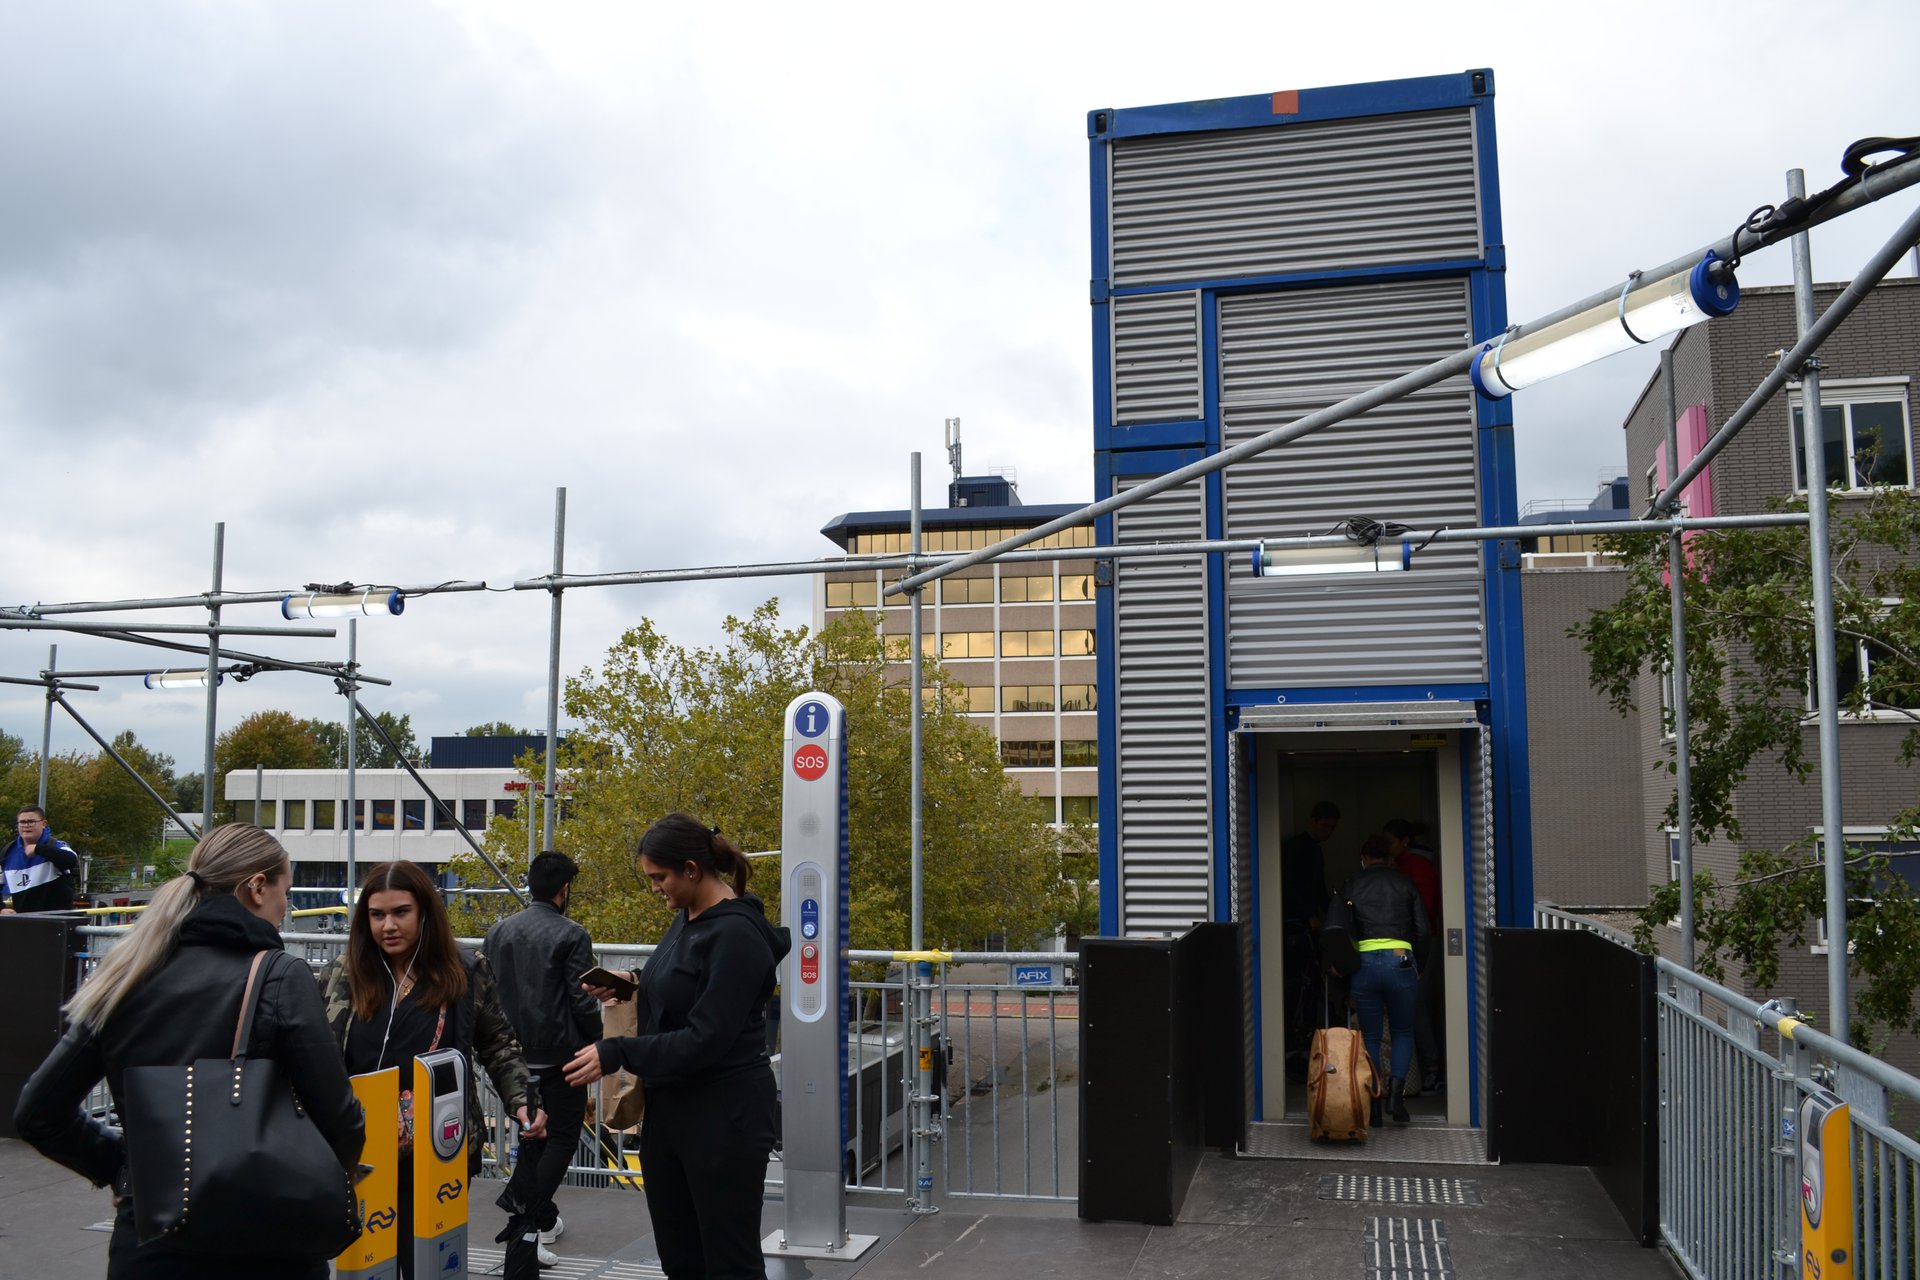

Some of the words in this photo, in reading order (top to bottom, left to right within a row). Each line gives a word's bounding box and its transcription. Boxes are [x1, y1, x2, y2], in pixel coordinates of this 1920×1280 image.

[796, 756, 825, 769] SOS
[435, 1221, 444, 1231] NS
[364, 1253, 374, 1263] NS
